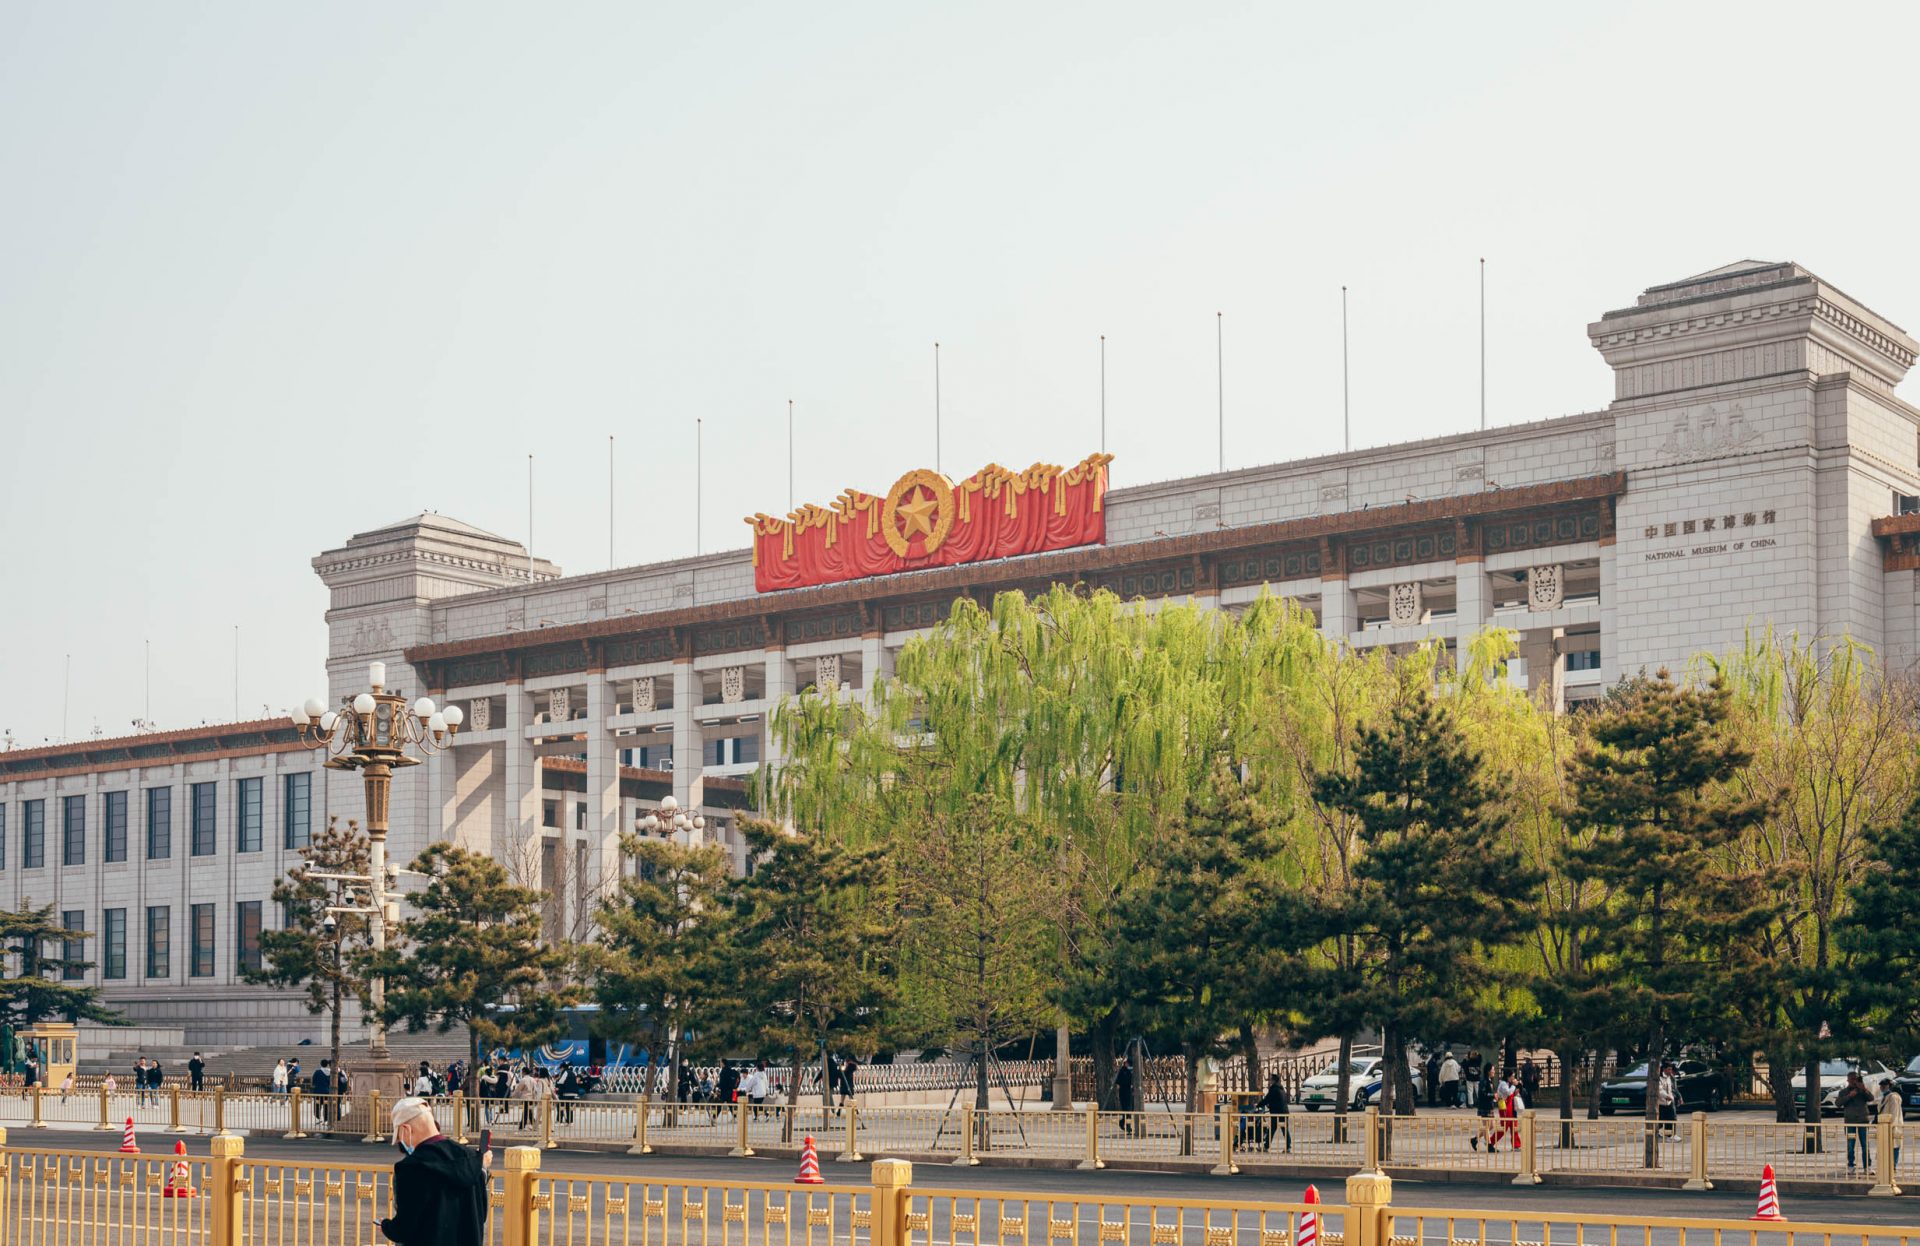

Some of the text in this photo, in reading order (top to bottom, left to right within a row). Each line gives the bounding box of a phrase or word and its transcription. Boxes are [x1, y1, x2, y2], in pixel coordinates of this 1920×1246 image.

[1645, 510, 1776, 539] 中国国家博物馆
[1645, 539, 1776, 561] NATIONAL MUSEUM OF CHINA
